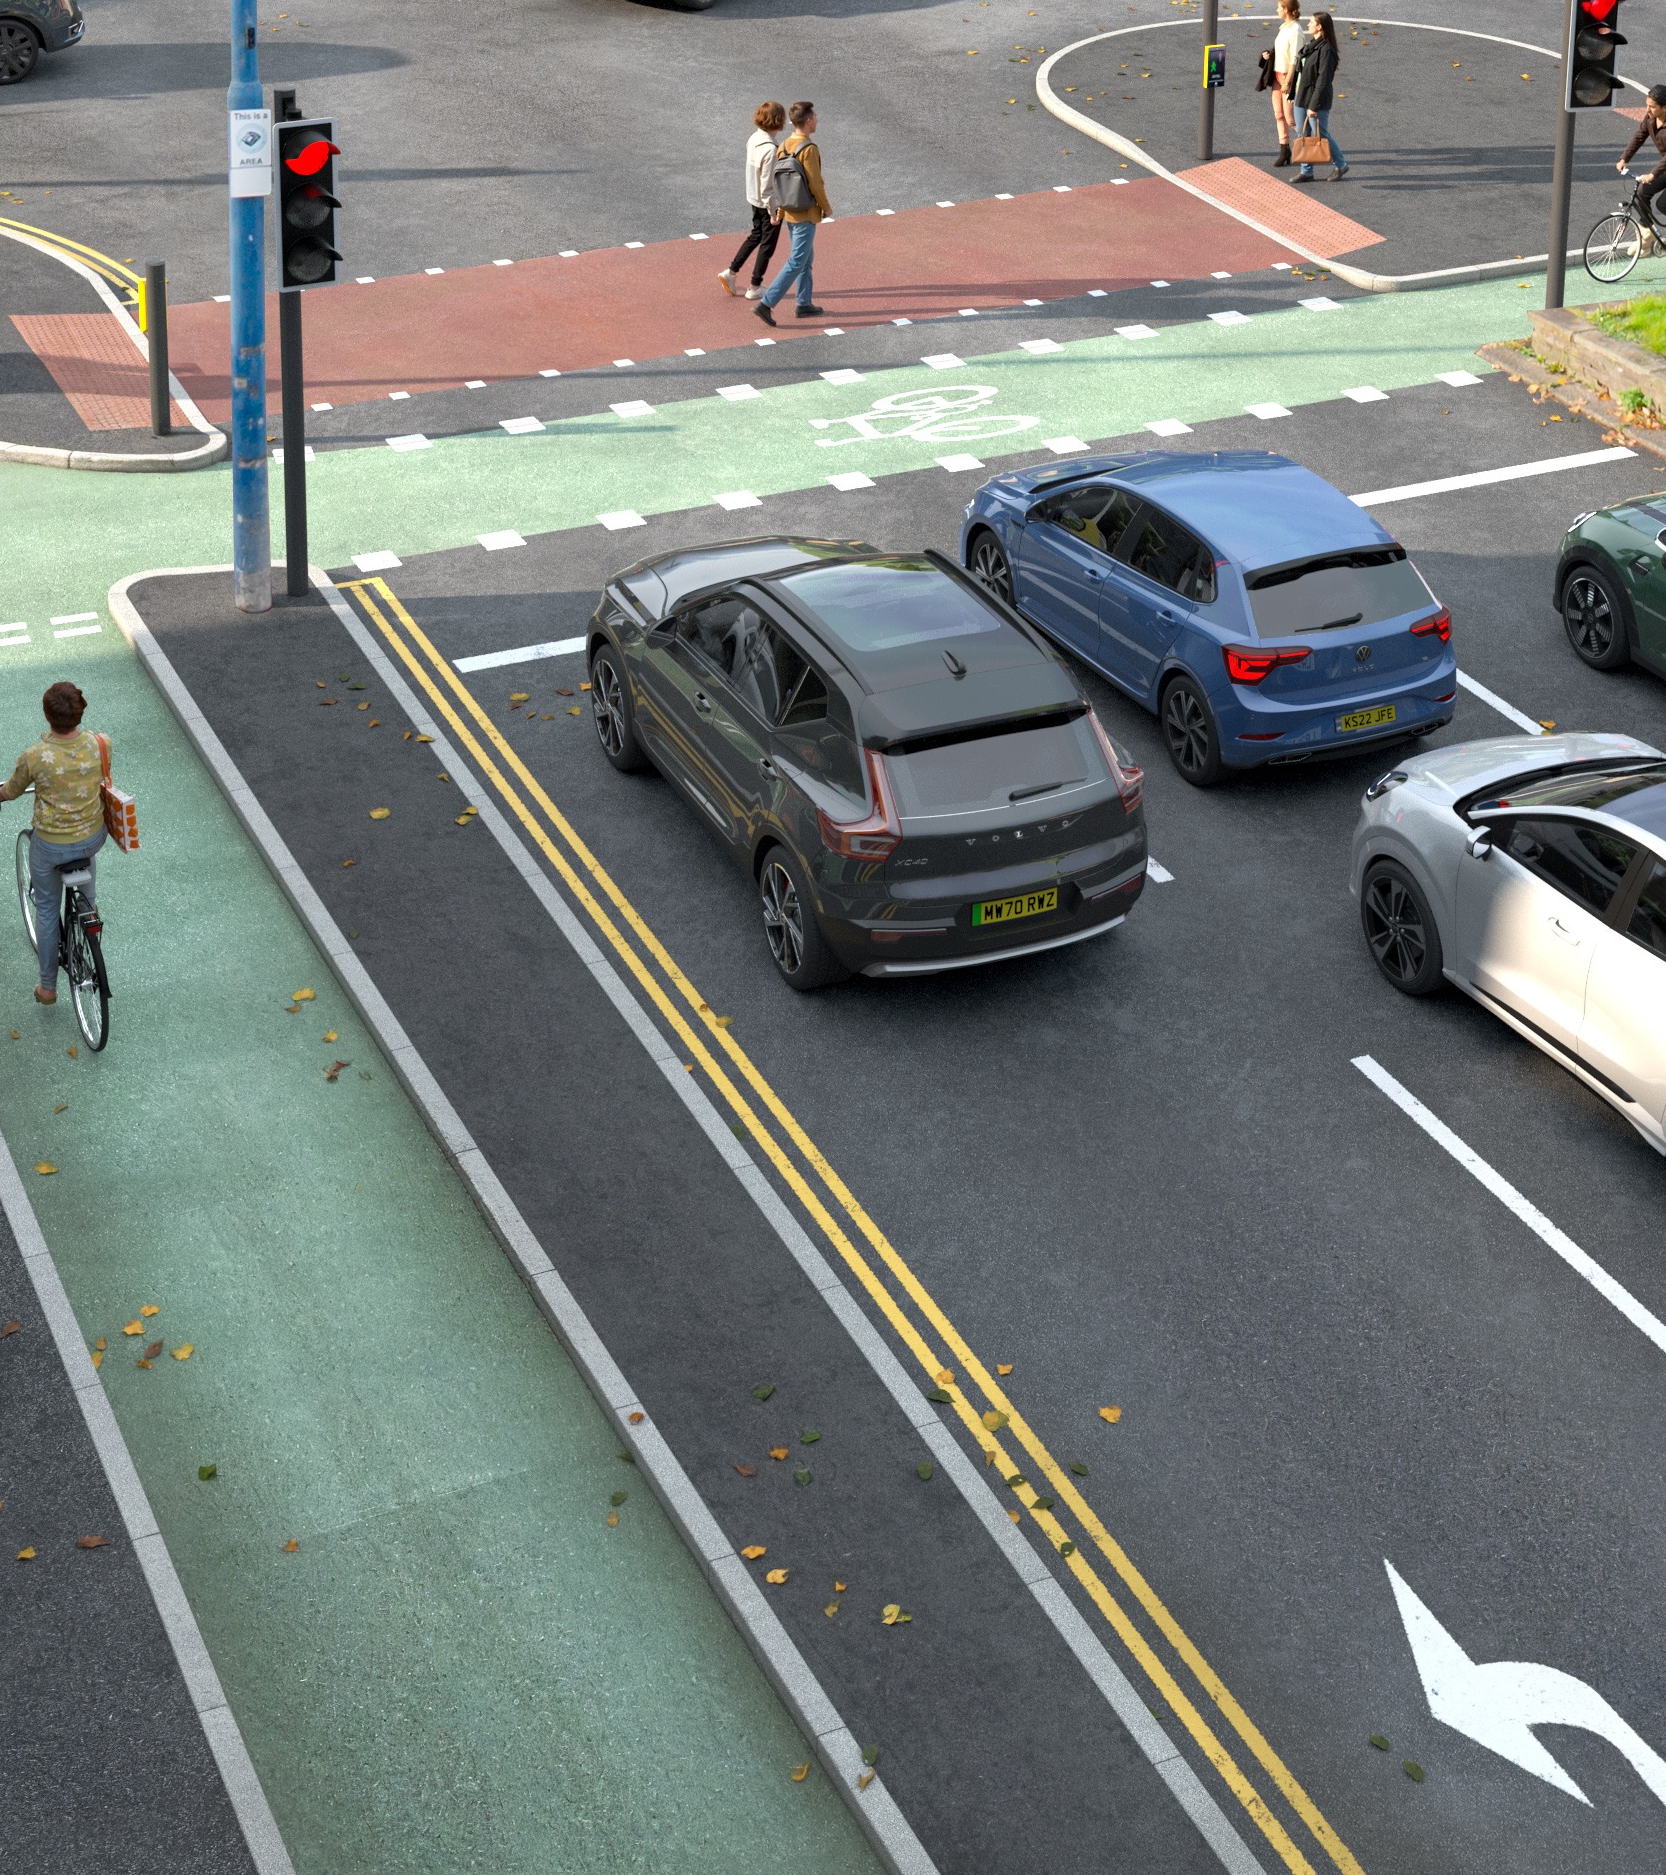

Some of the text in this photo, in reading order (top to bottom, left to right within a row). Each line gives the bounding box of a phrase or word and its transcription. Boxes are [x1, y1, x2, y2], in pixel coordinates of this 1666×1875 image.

[235, 112, 251, 120] This
[1344, 708, 1394, 729] KS22 JFE
[966, 820, 1070, 846] VOLVO
[895, 857, 929, 867] XC40
[984, 891, 1055, 921] MW70 RWZ
